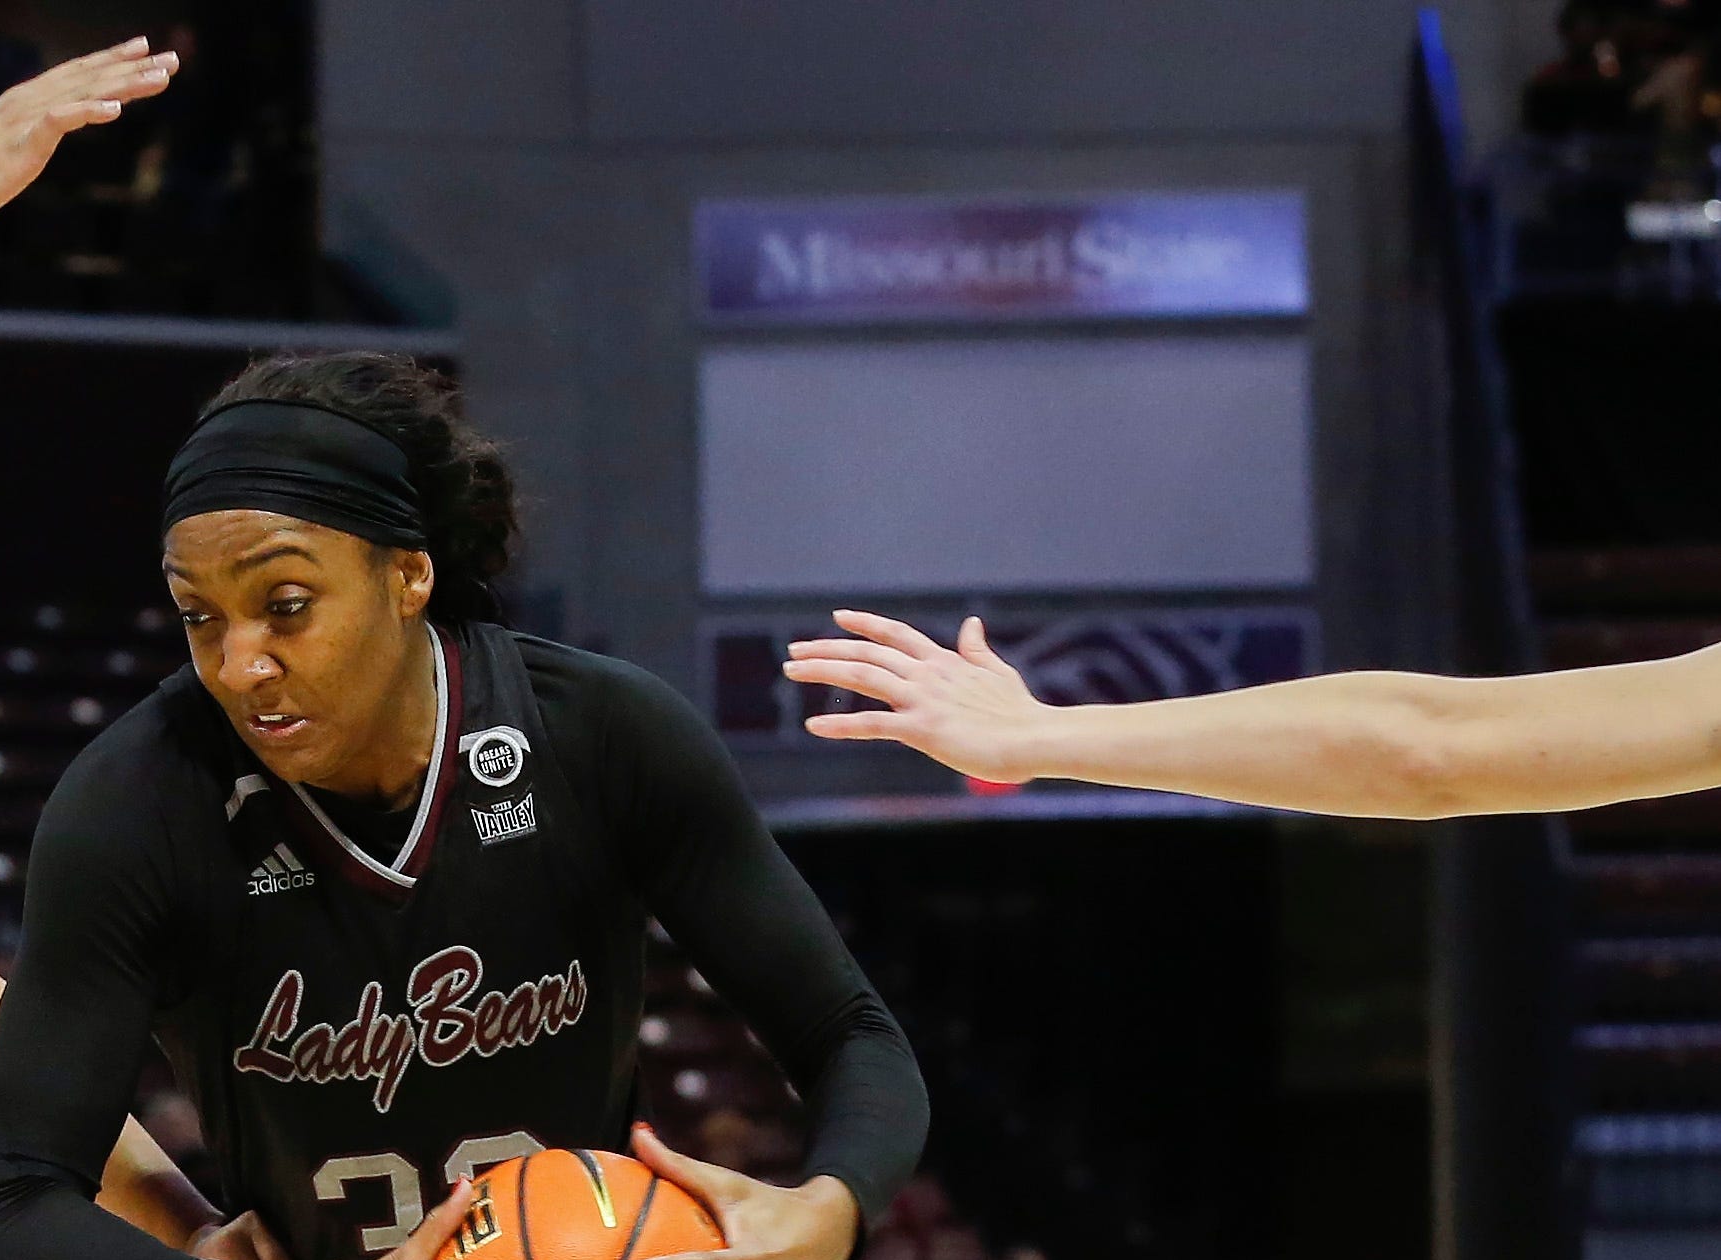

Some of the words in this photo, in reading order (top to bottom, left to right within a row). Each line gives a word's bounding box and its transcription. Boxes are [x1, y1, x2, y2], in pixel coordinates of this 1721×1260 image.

[481, 755, 514, 774] UNITE
[471, 793, 536, 840] VALLEY
[247, 871, 316, 895] adidas
[312, 1131, 548, 1255] 3
